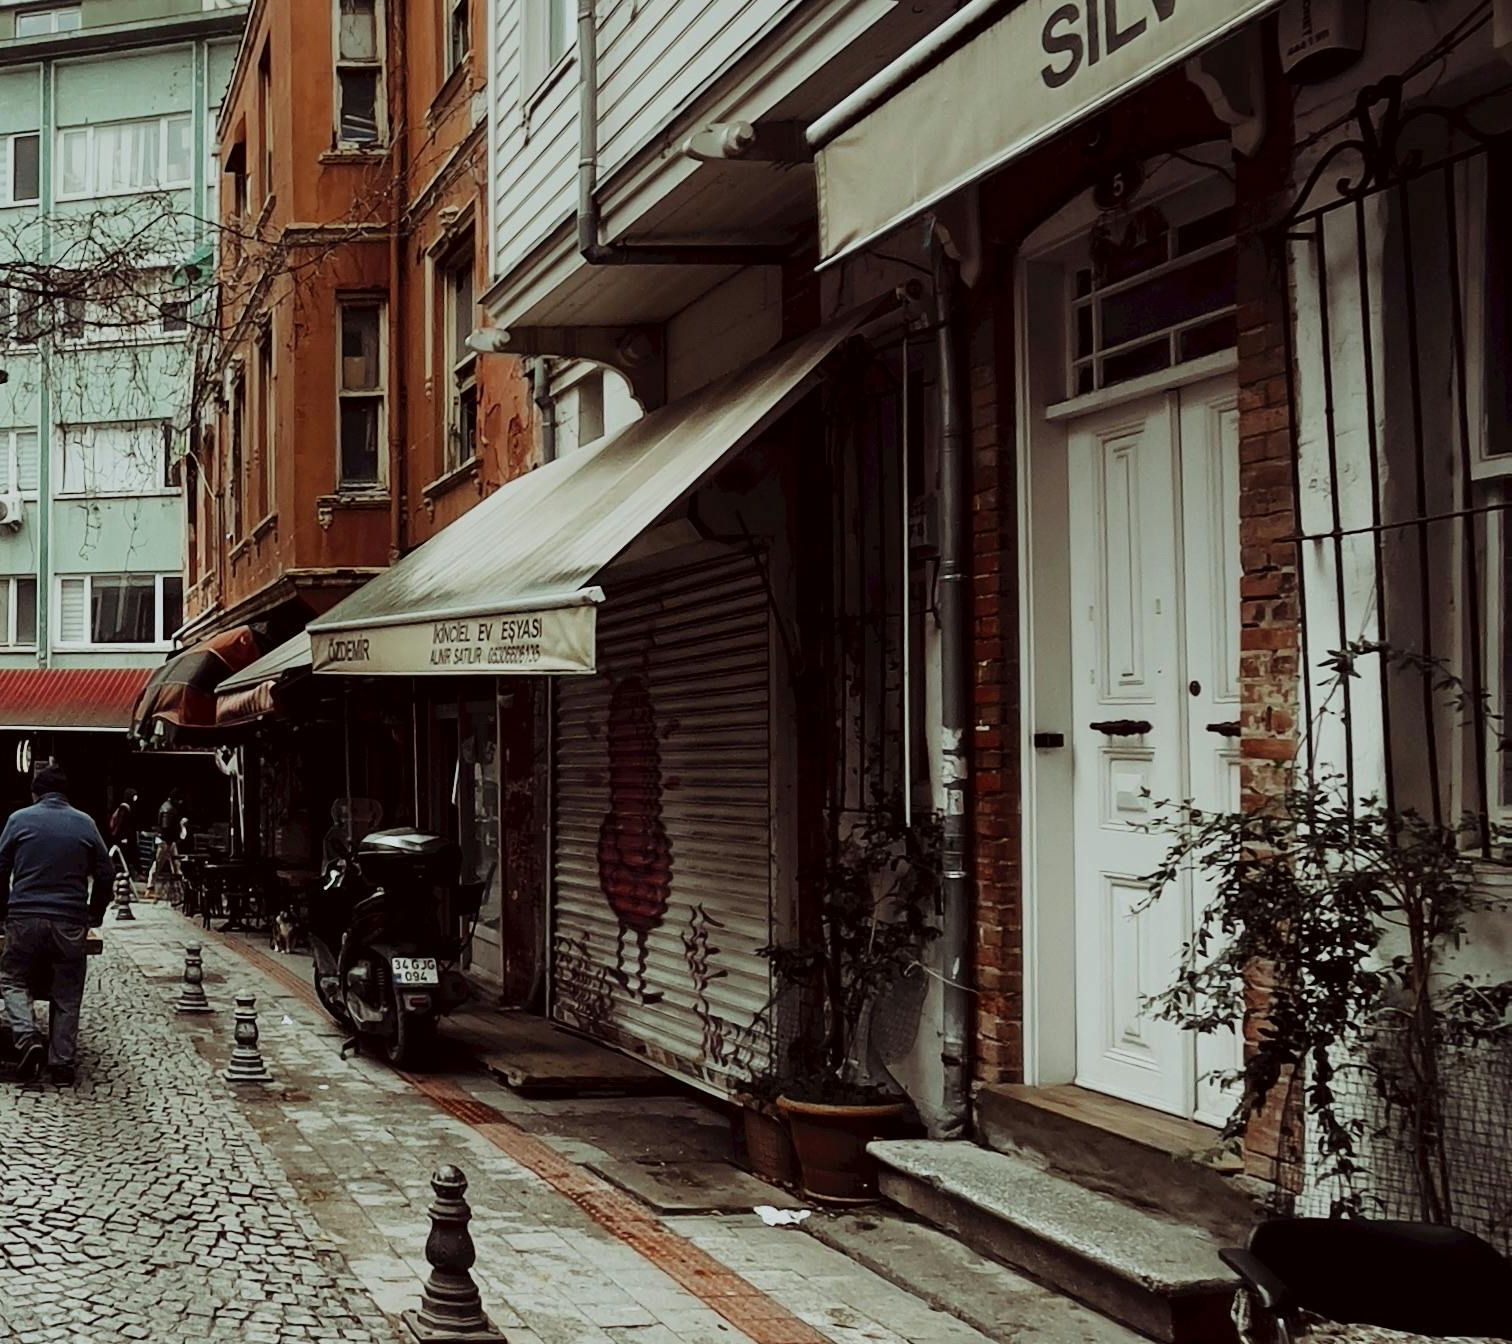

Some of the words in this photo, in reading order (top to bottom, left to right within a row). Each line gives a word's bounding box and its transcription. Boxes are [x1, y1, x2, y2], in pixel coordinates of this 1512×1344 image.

[1112, 171, 1125, 197] 5
[478, 623, 493, 642] EV
[501, 618, 543, 643] EŞYASI
[394, 959, 408, 970] 34
[405, 971, 427, 982] 094
